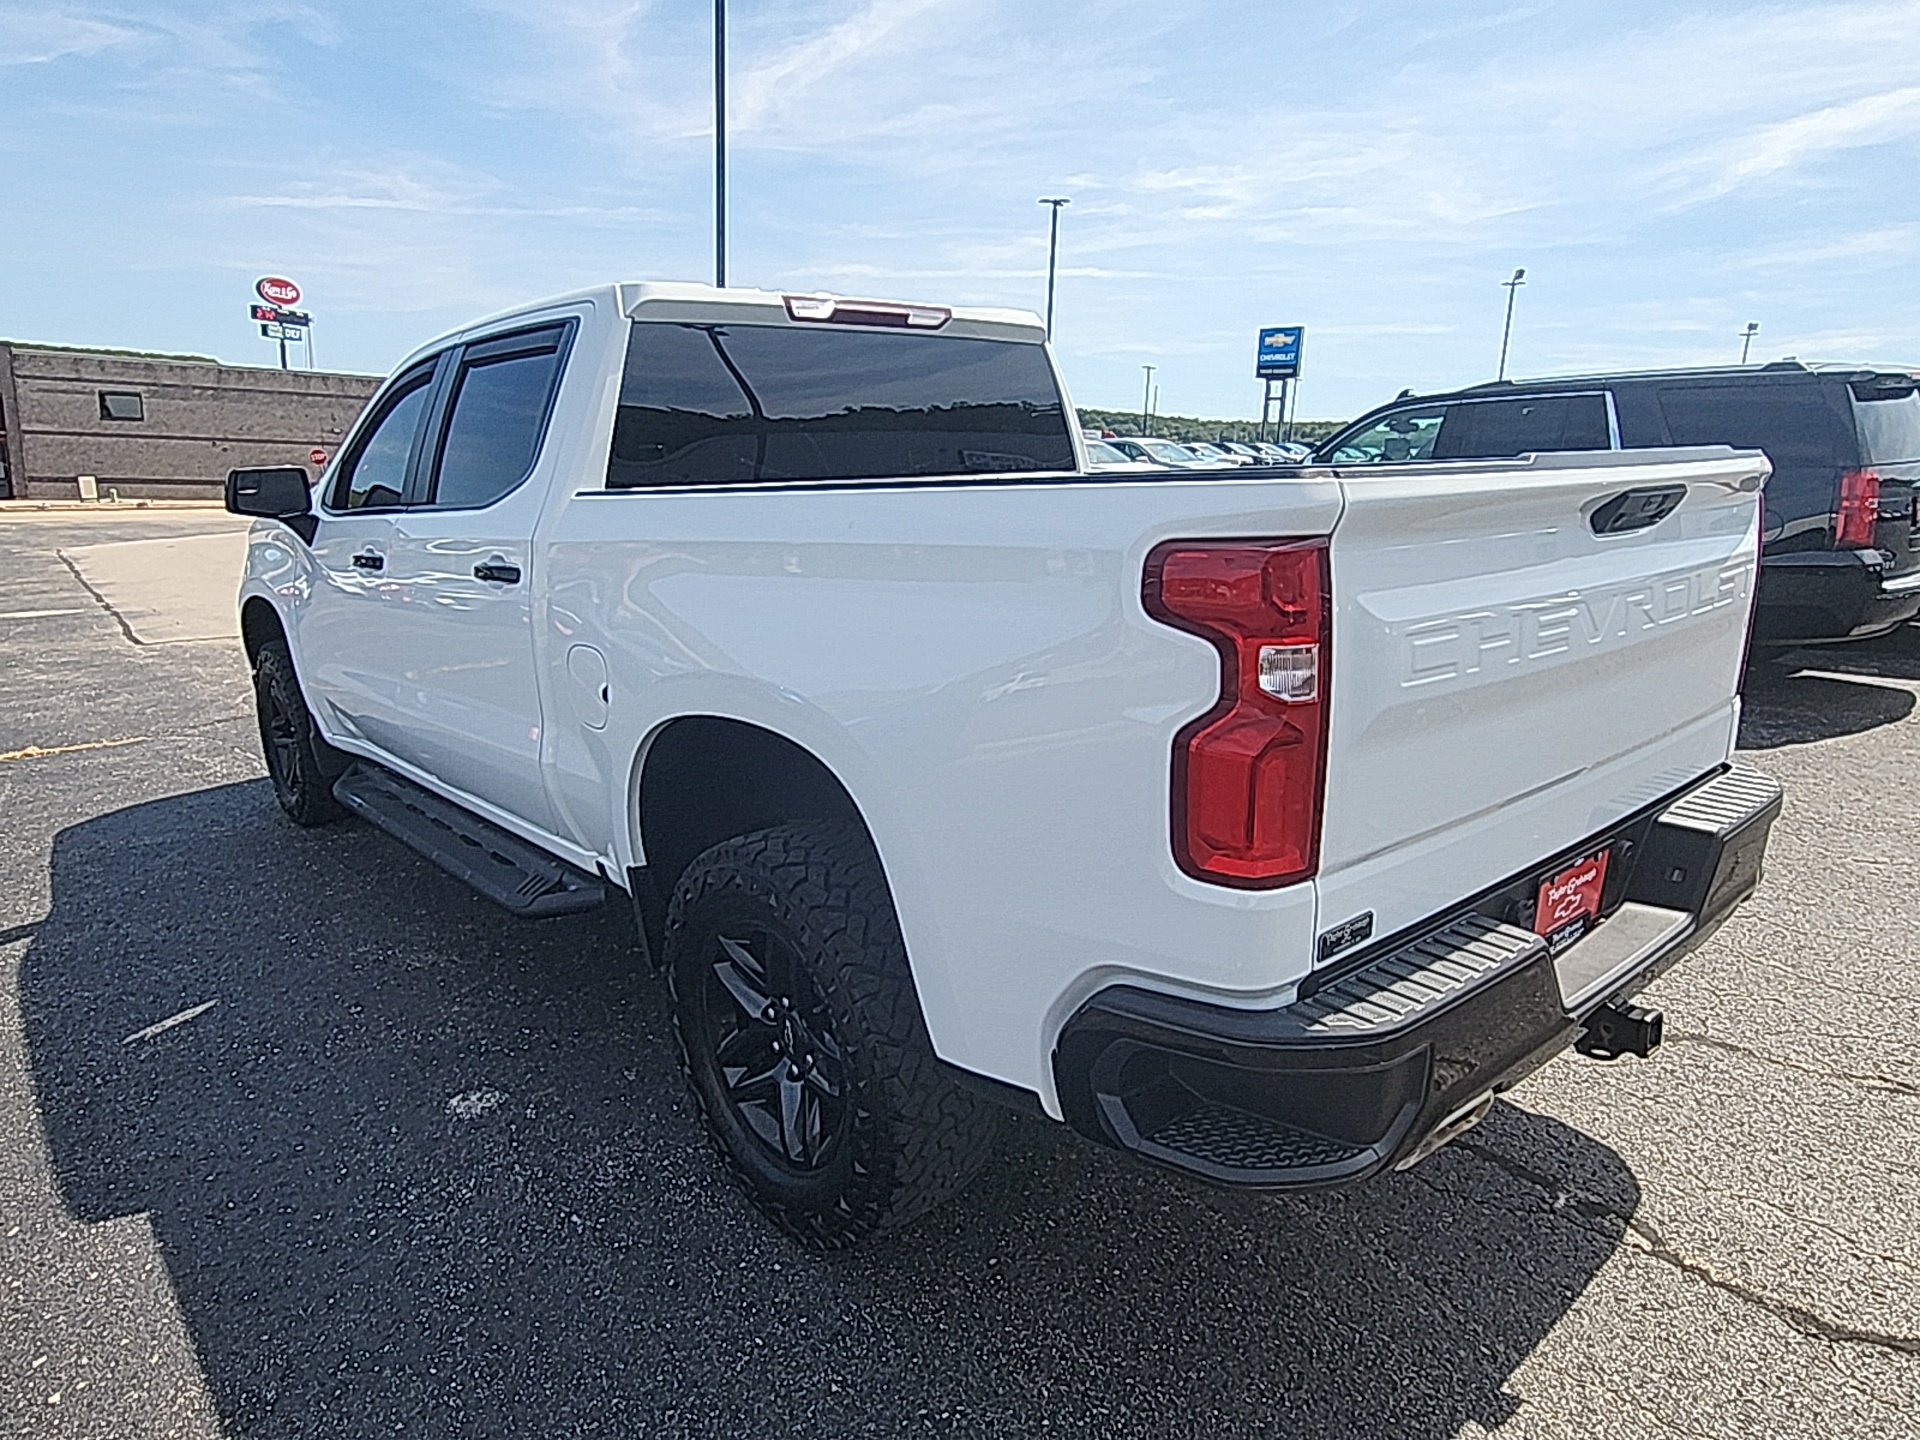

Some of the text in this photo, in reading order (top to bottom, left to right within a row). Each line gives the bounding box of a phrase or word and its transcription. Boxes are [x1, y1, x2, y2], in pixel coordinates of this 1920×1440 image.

[1259, 352, 1296, 362] CHEVROLET
[310, 452, 326, 462] STOP
[1400, 562, 1755, 687] CHEVROLET
